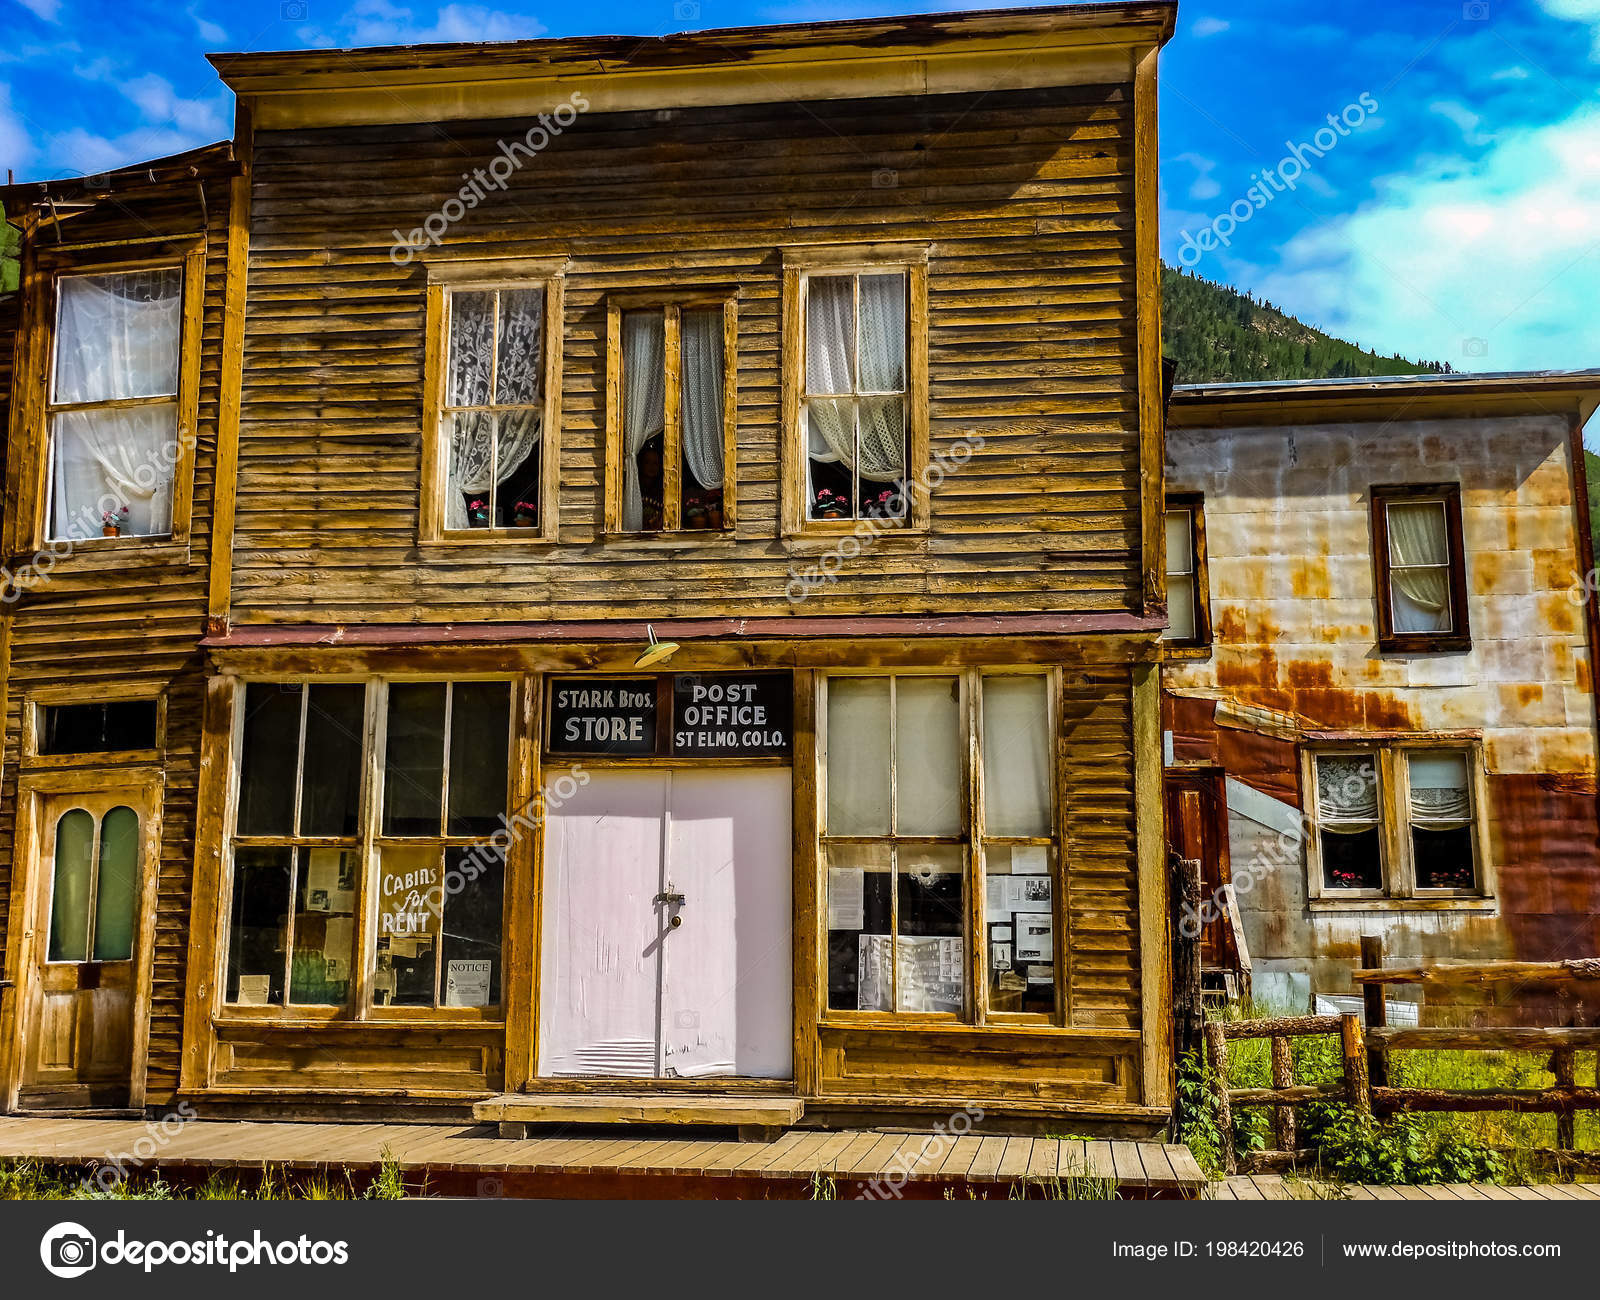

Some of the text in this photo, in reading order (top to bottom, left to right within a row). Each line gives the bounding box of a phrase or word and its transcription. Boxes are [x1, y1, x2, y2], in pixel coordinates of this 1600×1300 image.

[558, 690, 614, 709] STARK
[692, 684, 757, 703] POST
[684, 706, 767, 726] OFFICE
[565, 716, 643, 742] STORE
[675, 731, 787, 748] ST ELMO, COLO.
[400, 890, 428, 912] for
[382, 913, 430, 933] RENT
[450, 963, 489, 972] NOTICE
